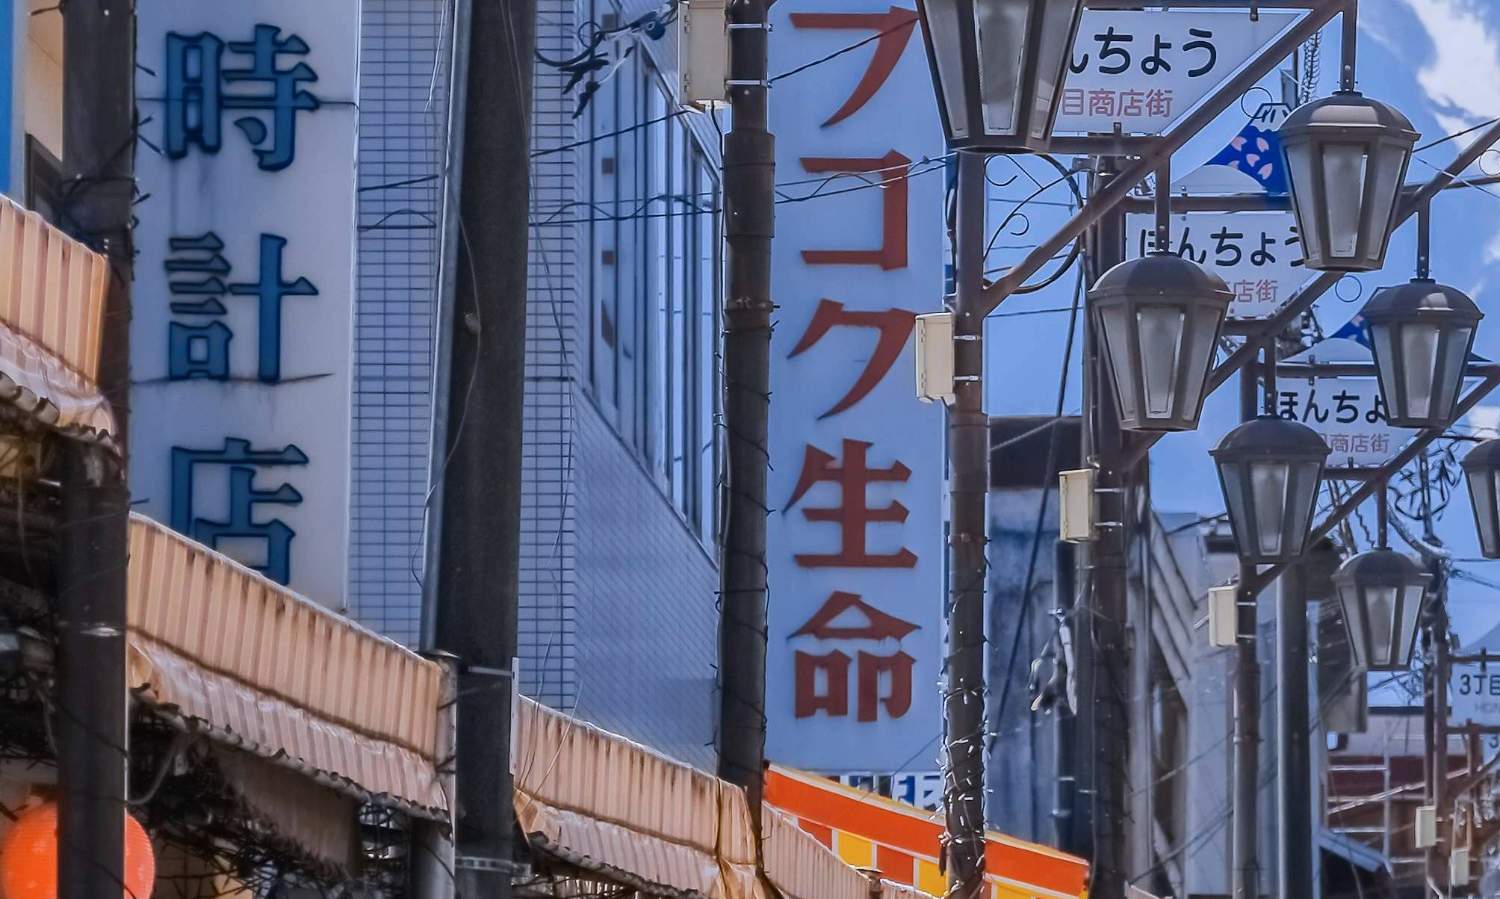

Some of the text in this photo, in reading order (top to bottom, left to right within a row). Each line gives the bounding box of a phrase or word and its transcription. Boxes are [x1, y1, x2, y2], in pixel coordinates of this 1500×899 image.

[1061, 88, 1174, 117] 目商店街
[164, 23, 319, 586] 時計店
[782, 5, 922, 723] フコク生命
[1227, 279, 1279, 303] 店街
